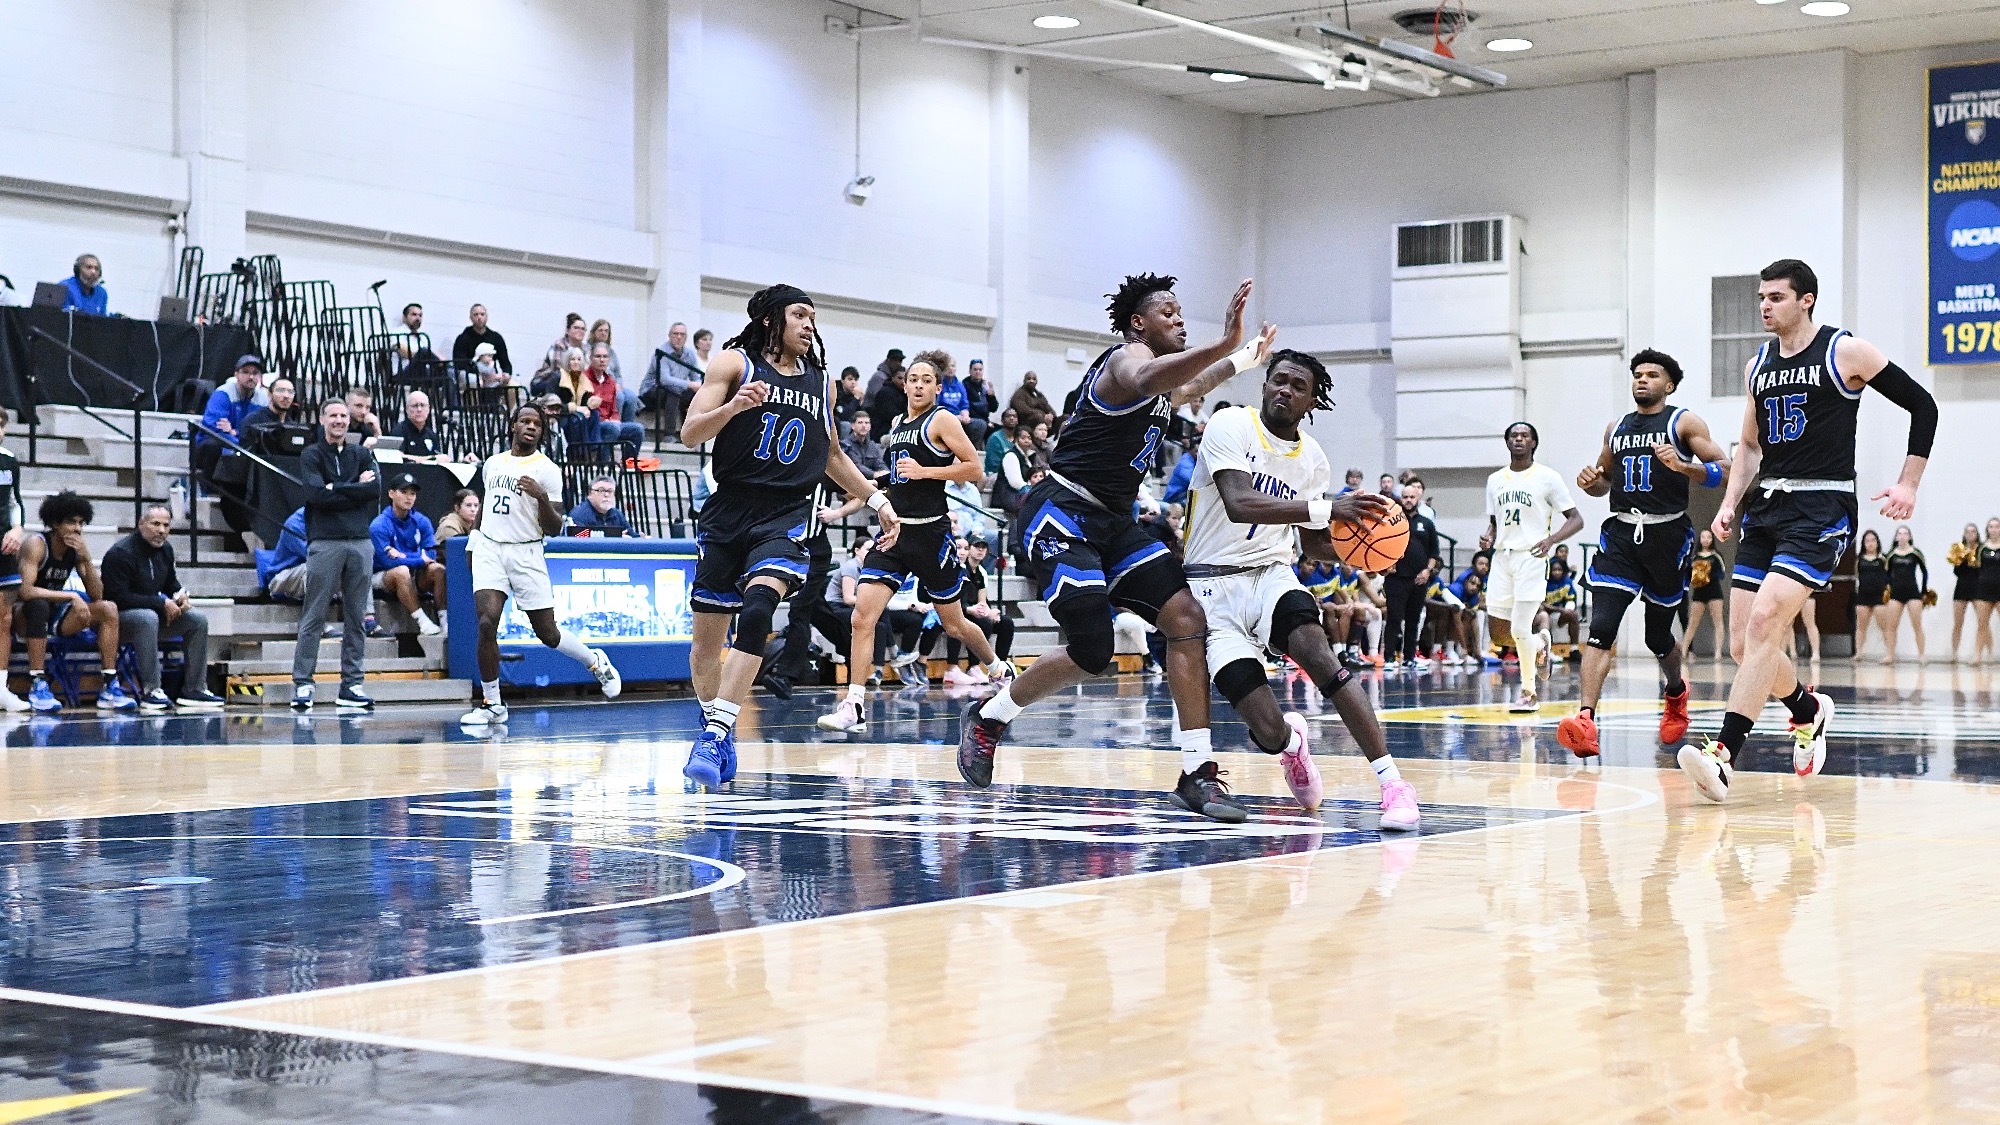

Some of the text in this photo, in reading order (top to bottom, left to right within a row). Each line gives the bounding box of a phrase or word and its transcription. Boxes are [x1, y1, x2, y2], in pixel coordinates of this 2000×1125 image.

[1756, 364, 1821, 396] MARIAN
[1764, 392, 1808, 444] 15
[753, 411, 806, 465] 10
[1613, 432, 1666, 454] MARIAN
[1622, 454, 1653, 492] 11
[492, 494, 511, 515] 25
[1497, 490, 1532, 508] VIKINGS
[1504, 508, 1521, 526] 24
